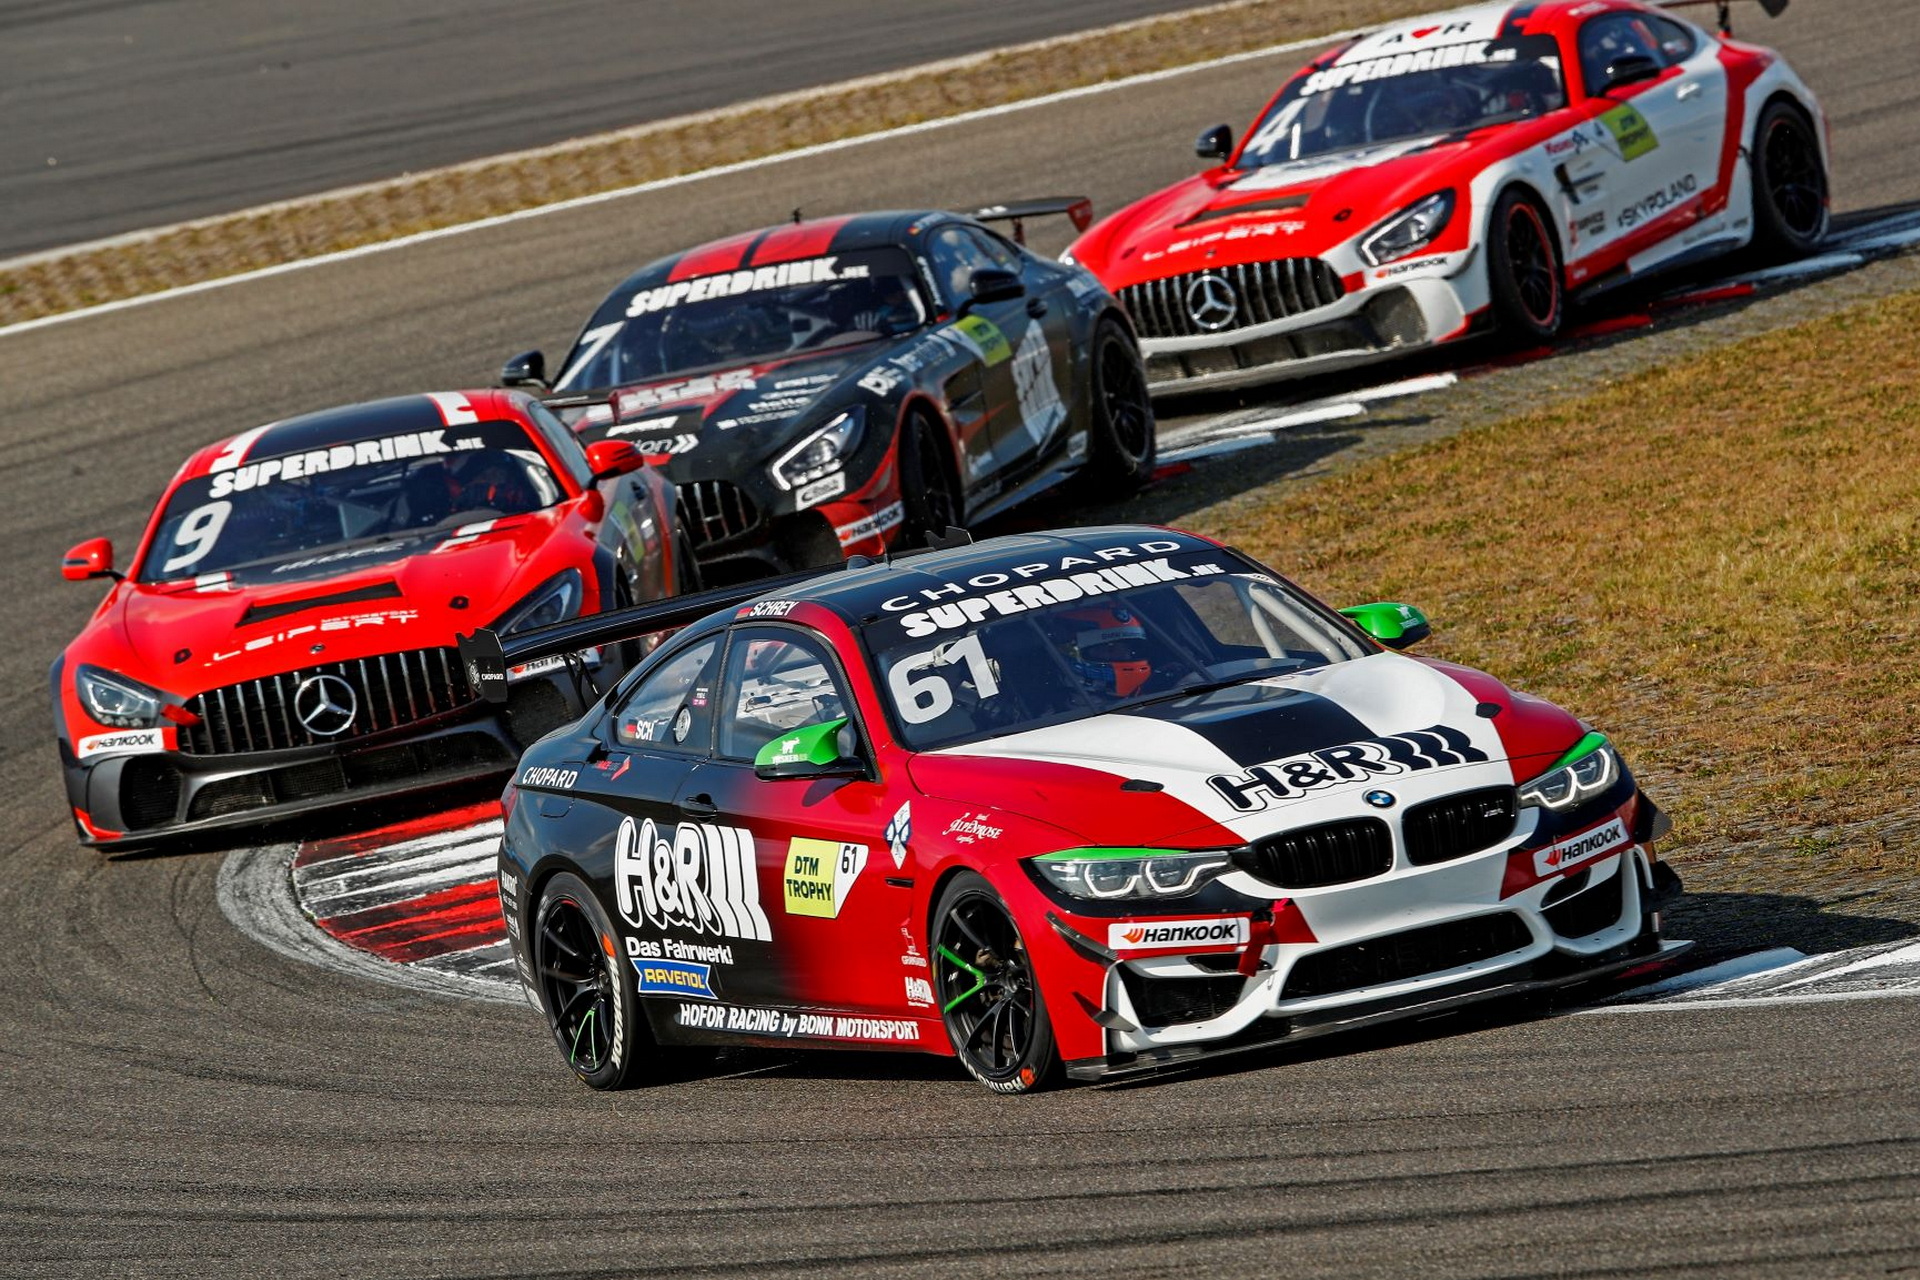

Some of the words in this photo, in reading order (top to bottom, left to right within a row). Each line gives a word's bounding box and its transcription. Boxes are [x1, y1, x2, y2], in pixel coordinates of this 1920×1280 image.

[1242, 98, 1309, 160] 4
[553, 320, 625, 391] 7
[163, 500, 233, 574] 9
[881, 541, 1181, 612] CHOPARD
[750, 600, 800, 617] SCHREY
[481, 673, 504, 681] CHOPARD
[888, 634, 1001, 725] 61
[522, 766, 578, 788] CHOPARD
[794, 855, 820, 877] DTM
[840, 844, 858, 875] 61
[786, 879, 832, 902] TROPHY
[625, 936, 662, 958] Das
[662, 939, 735, 965] Fahrwerk!
[643, 968, 707, 990] RAVENOL
[679, 1003, 725, 1029] HOFOR
[726, 1005, 780, 1033] RACING
[782, 1013, 798, 1038] by
[797, 1014, 833, 1037] BONK
[836, 1017, 921, 1040] MOTORSPORT
